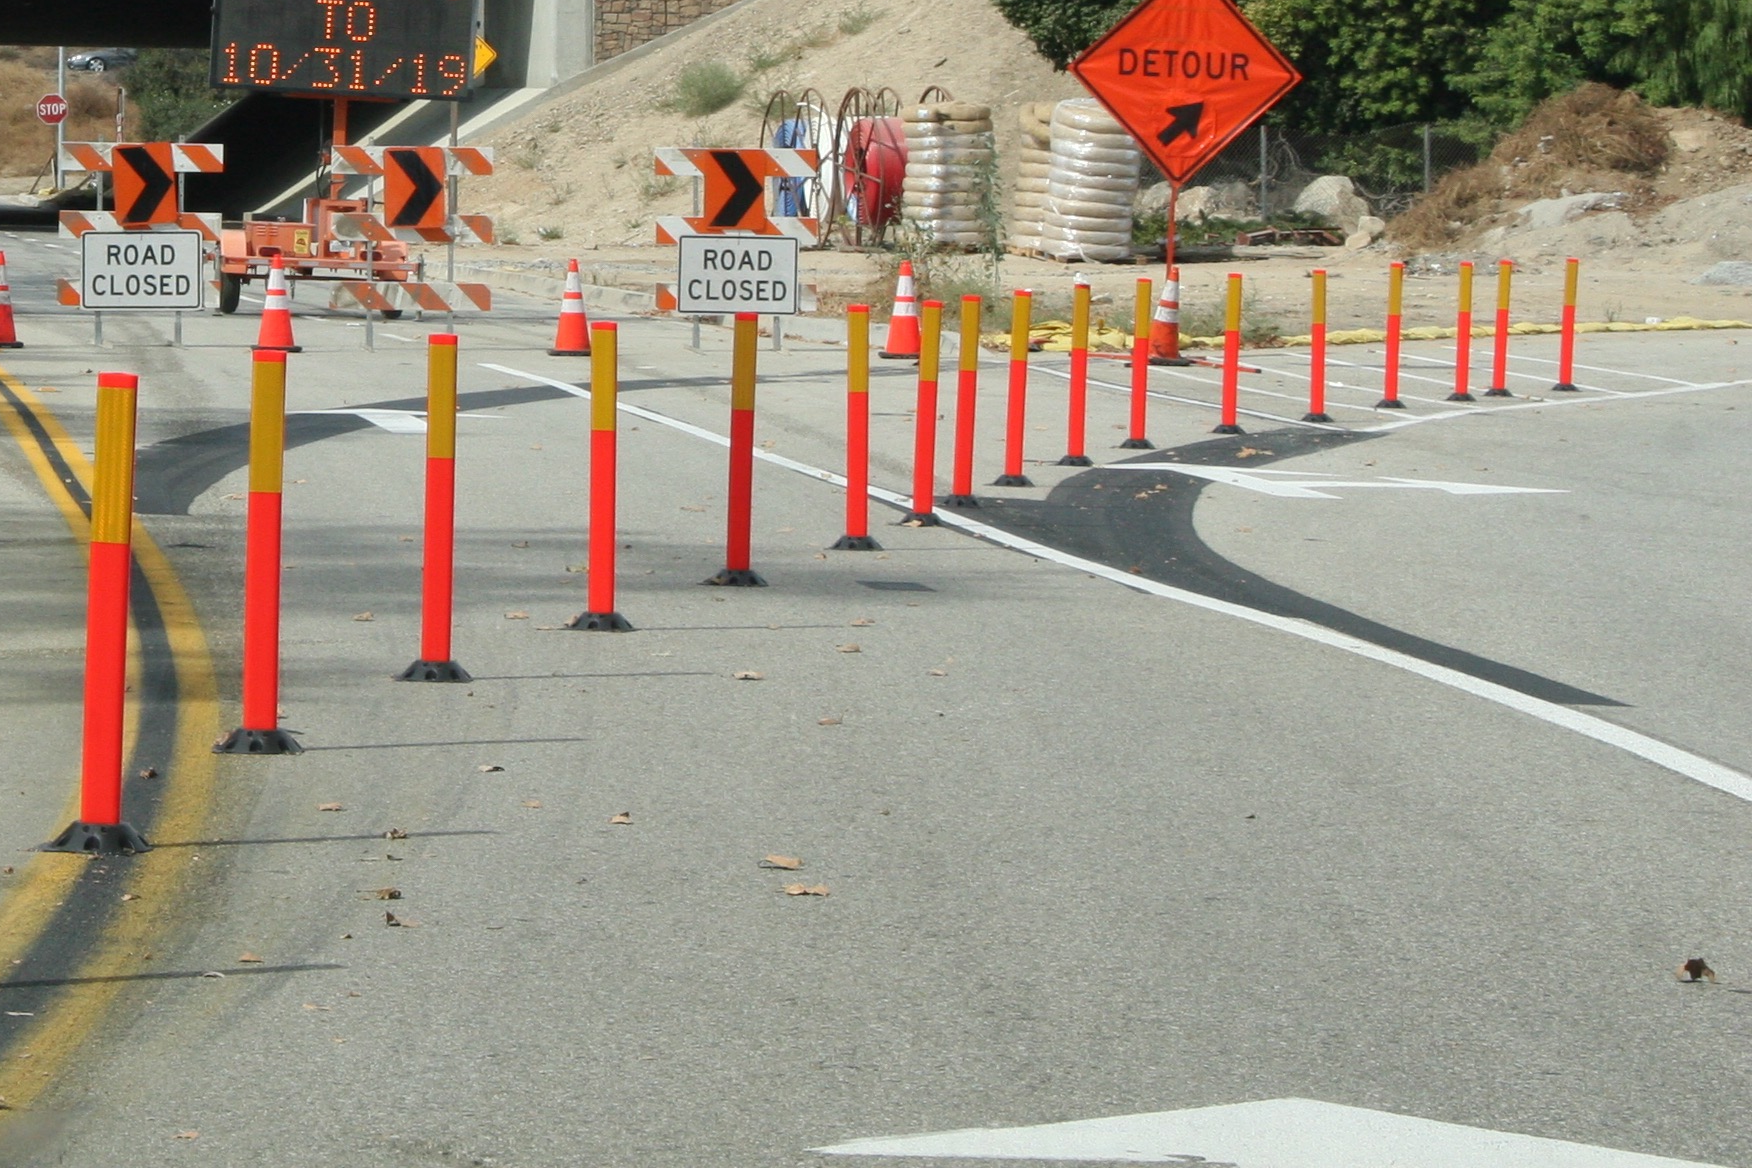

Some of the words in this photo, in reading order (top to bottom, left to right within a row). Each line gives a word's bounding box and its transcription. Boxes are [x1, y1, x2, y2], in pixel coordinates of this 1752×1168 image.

[221, 41, 467, 96] 10/31/19
[1117, 48, 1250, 81] DETOUR
[39, 104, 67, 116] STOP
[106, 244, 175, 266] ROAD
[702, 249, 773, 271] ROAD
[92, 274, 191, 296] CLOSED
[688, 279, 788, 302] CLOSED
